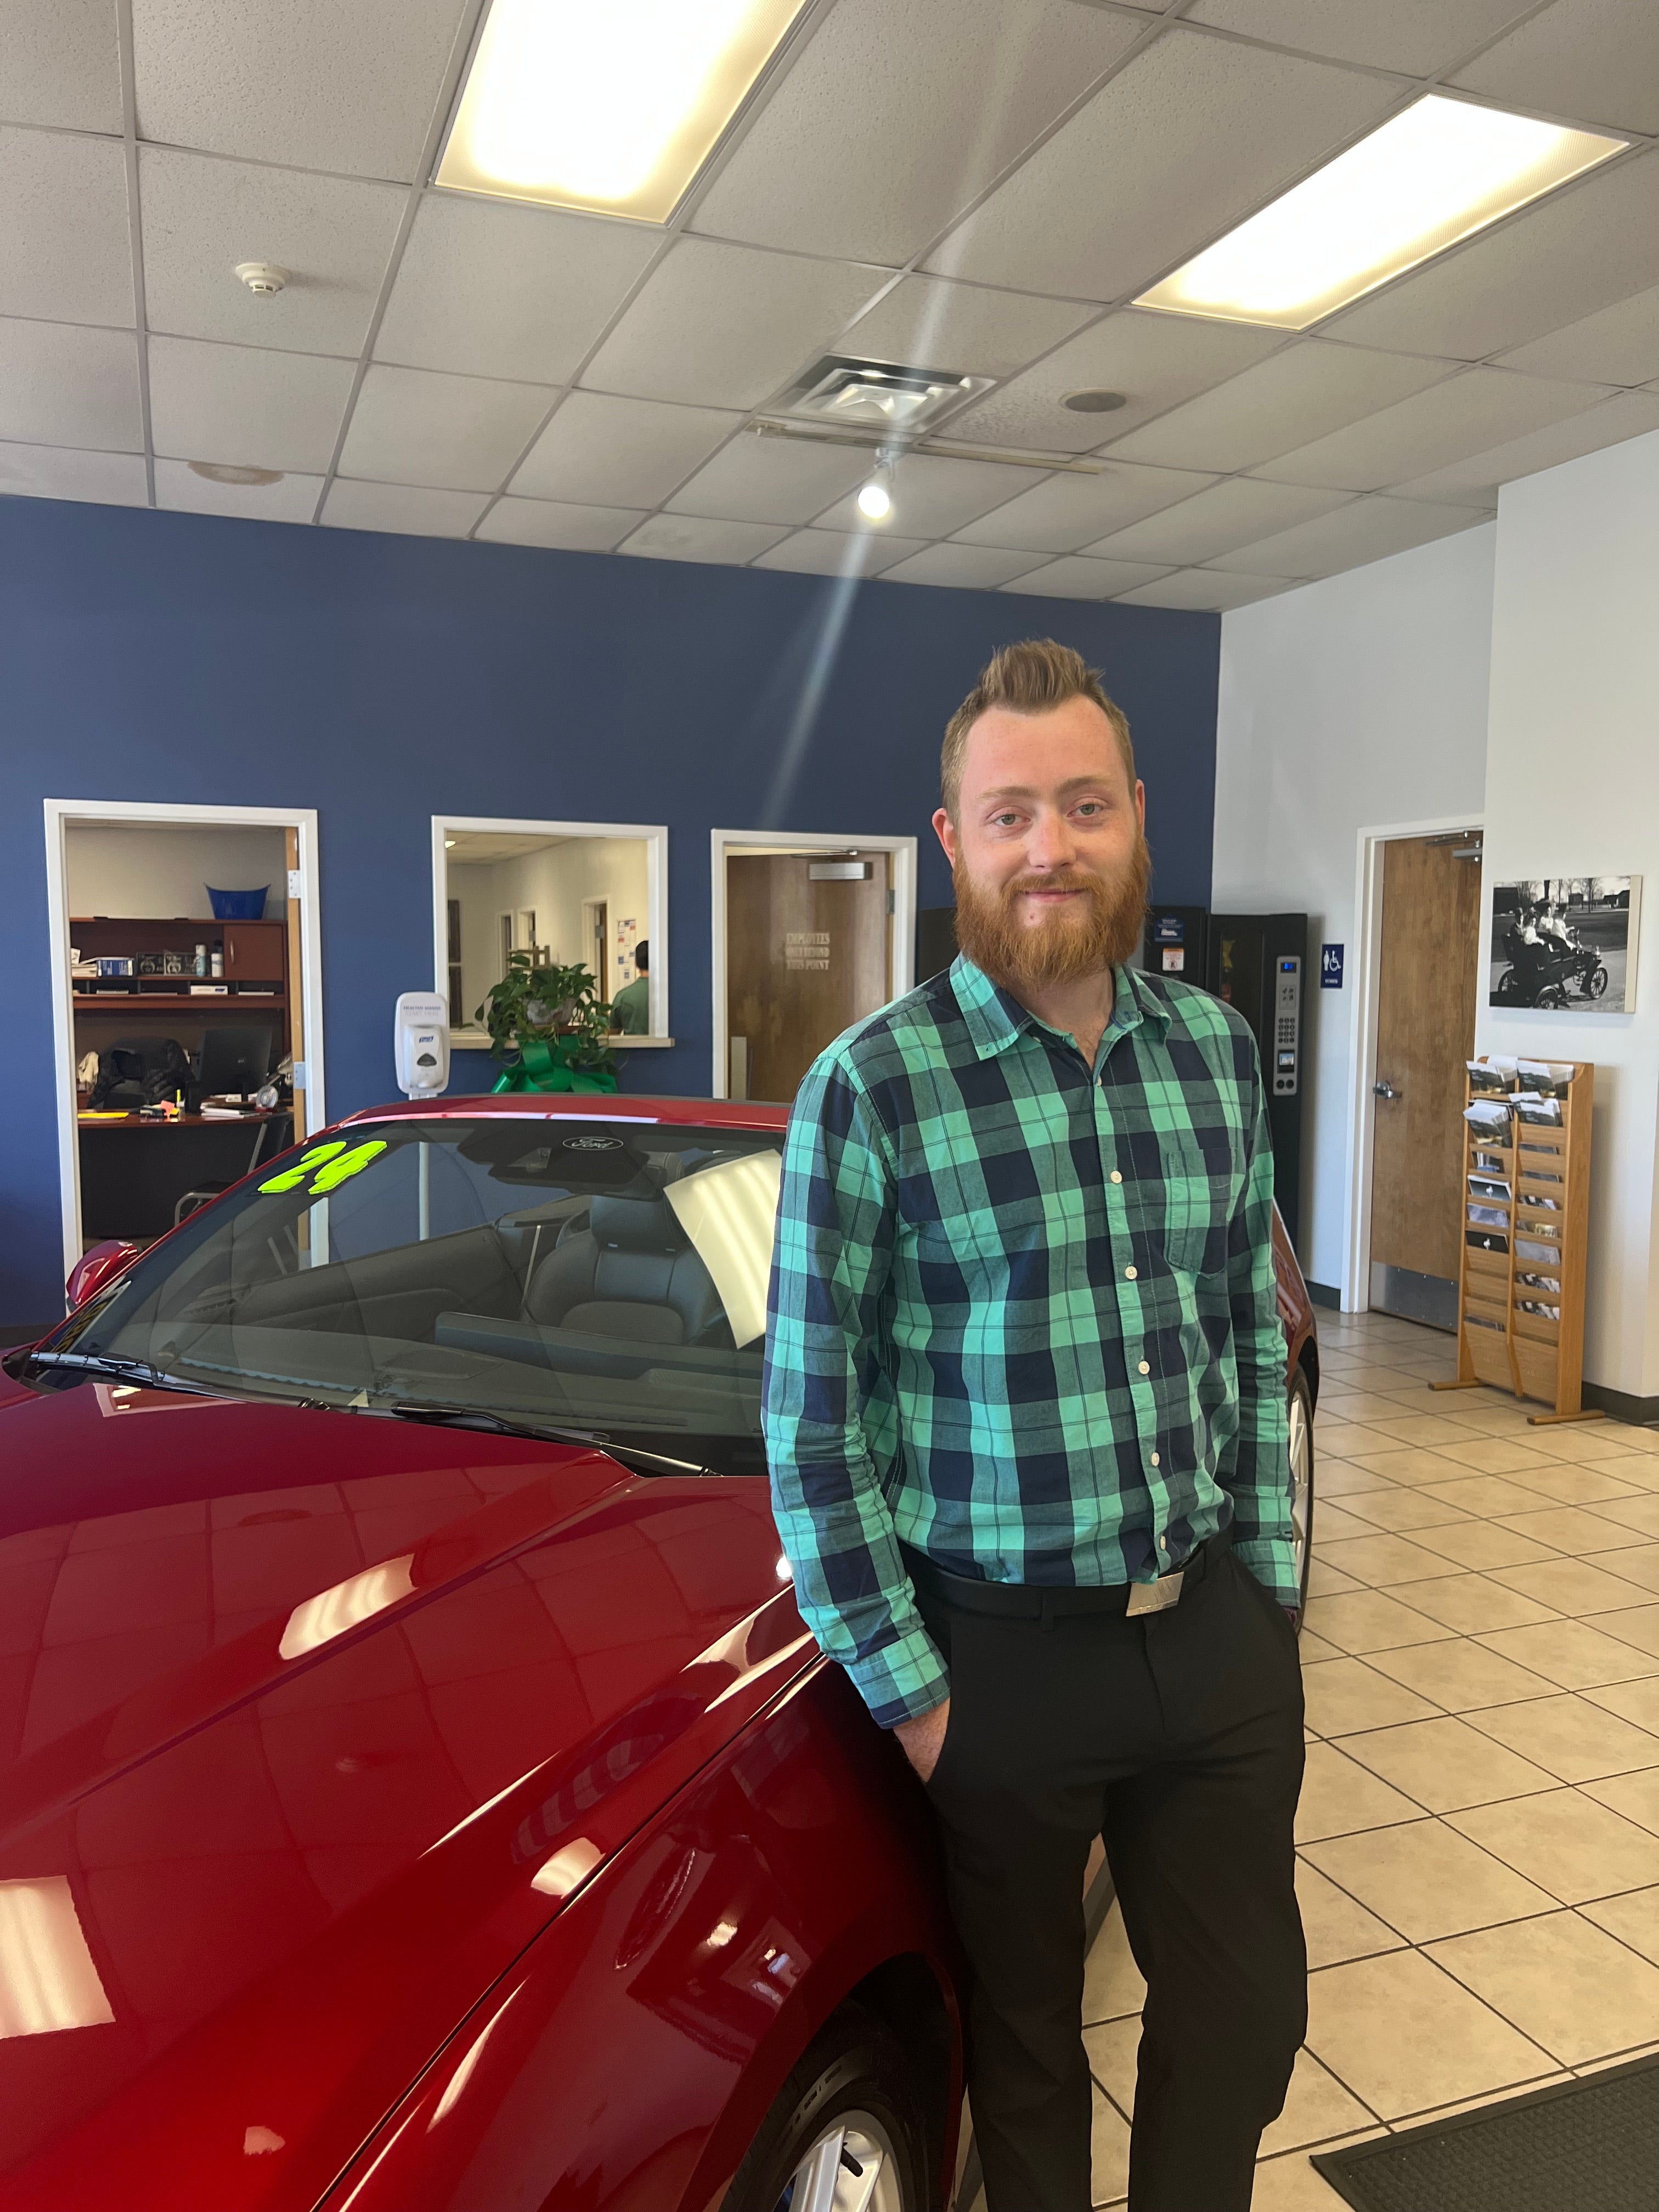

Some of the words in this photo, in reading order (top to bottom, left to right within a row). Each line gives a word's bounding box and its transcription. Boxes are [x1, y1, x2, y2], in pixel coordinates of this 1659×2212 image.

[805, 960, 829, 970] POINT
[571, 1138, 614, 1149] Ford
[257, 1141, 387, 1195] 24
